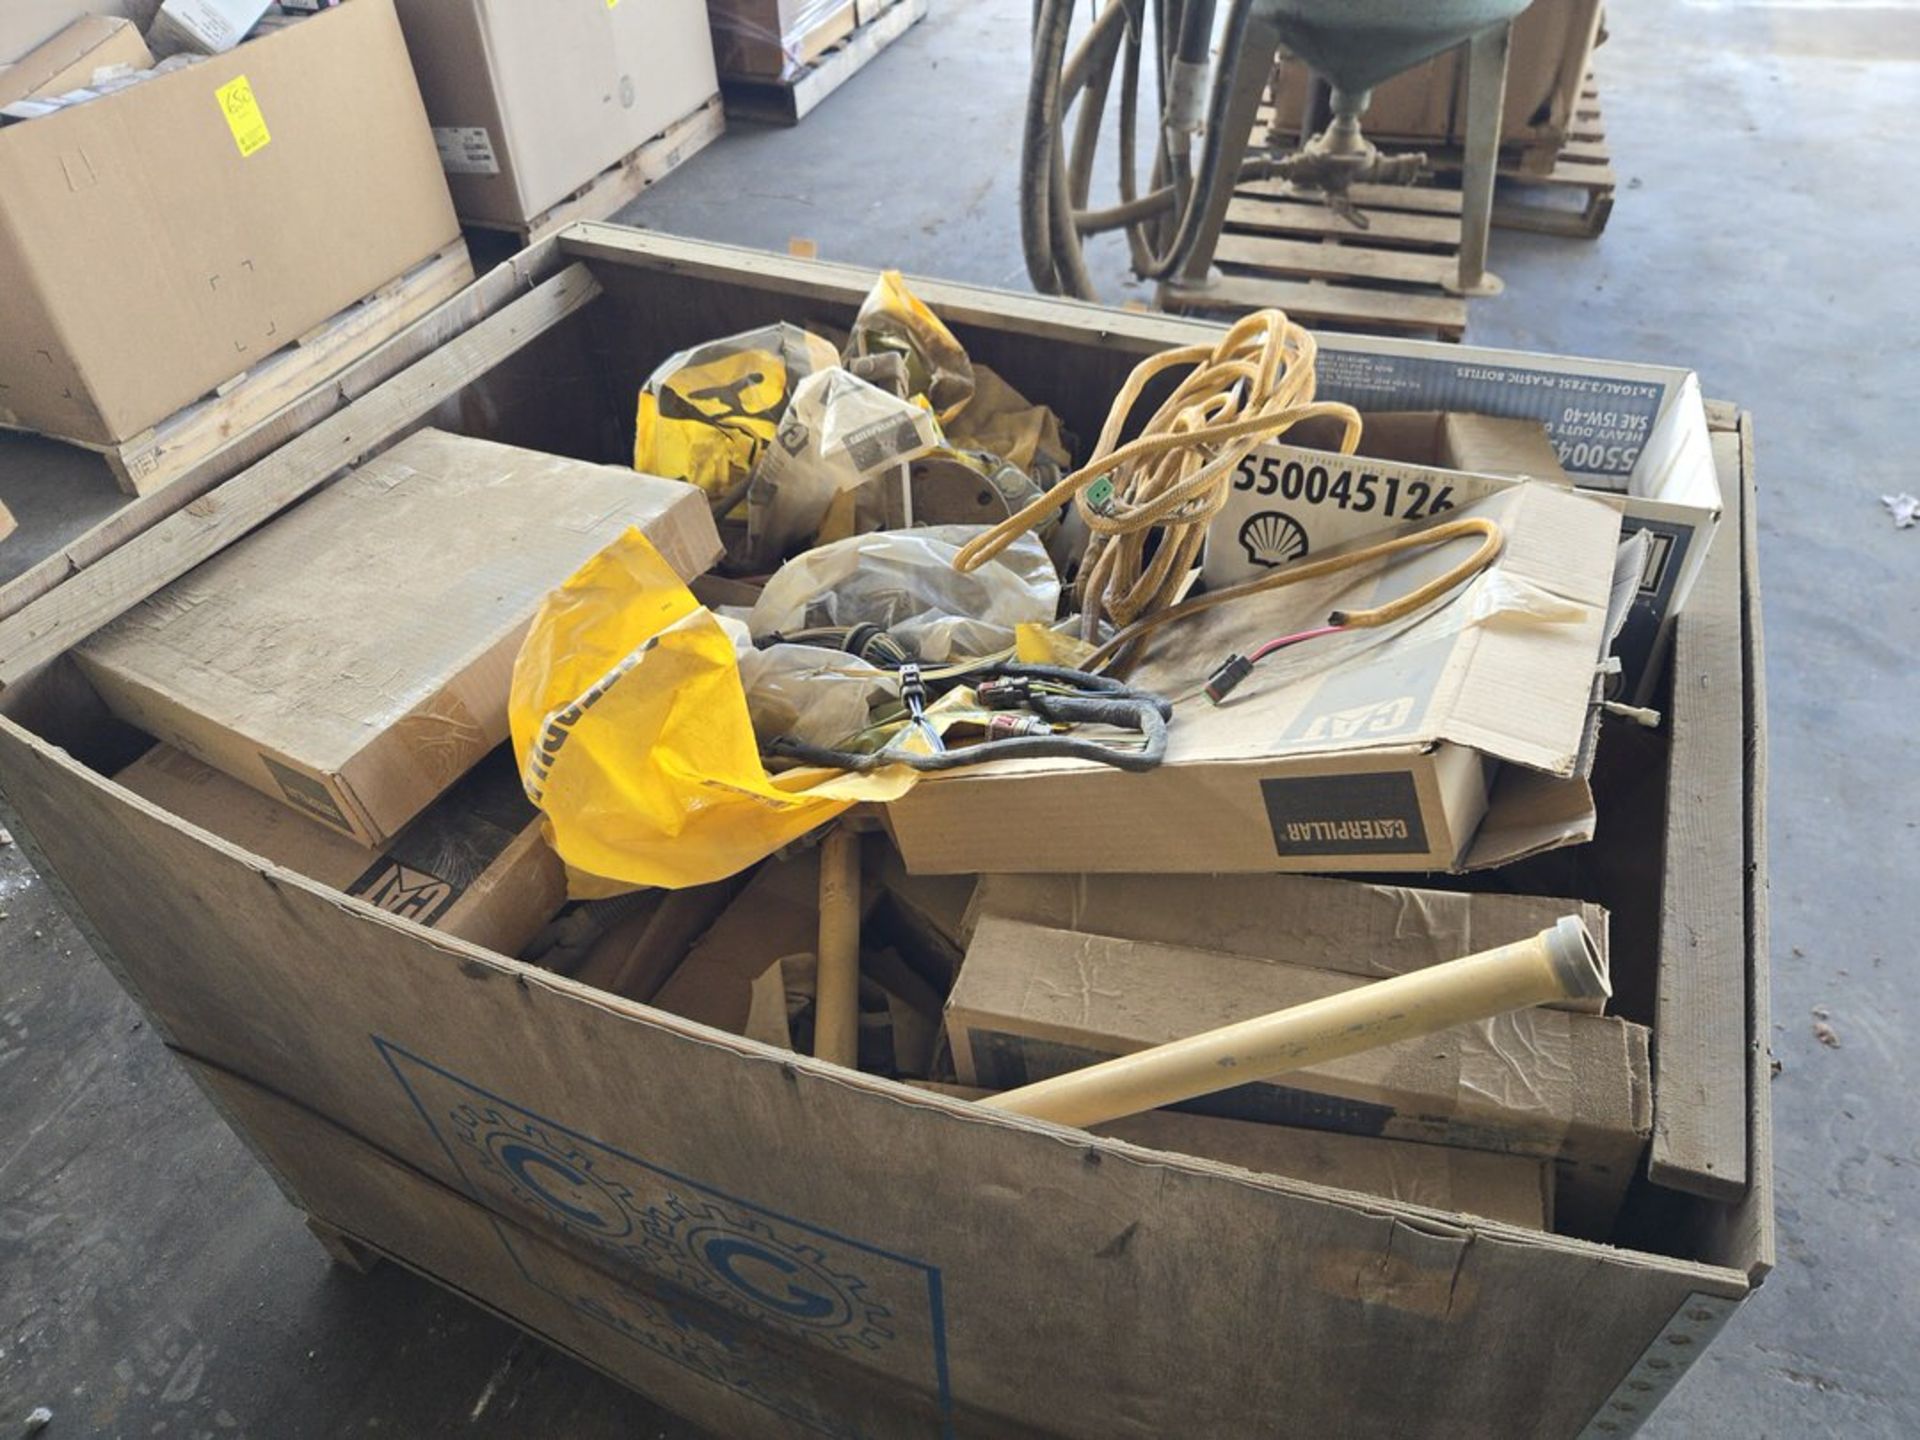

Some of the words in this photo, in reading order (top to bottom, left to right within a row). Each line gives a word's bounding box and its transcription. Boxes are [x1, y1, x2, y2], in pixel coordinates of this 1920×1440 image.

[1456, 368, 1504, 382] BOTTLES
[1507, 373, 1554, 388] PLASTIC
[1563, 408, 1616, 428] 15W-40
[1622, 414, 1648, 430] SAE
[1557, 425, 1594, 438] DUTY
[1596, 429, 1644, 442] HEAVY
[1550, 441, 1639, 472] 55004
[1233, 453, 1455, 522] 550045126
[1293, 697, 1412, 743] CAT
[1287, 818, 1408, 842] CATERPILLAR
